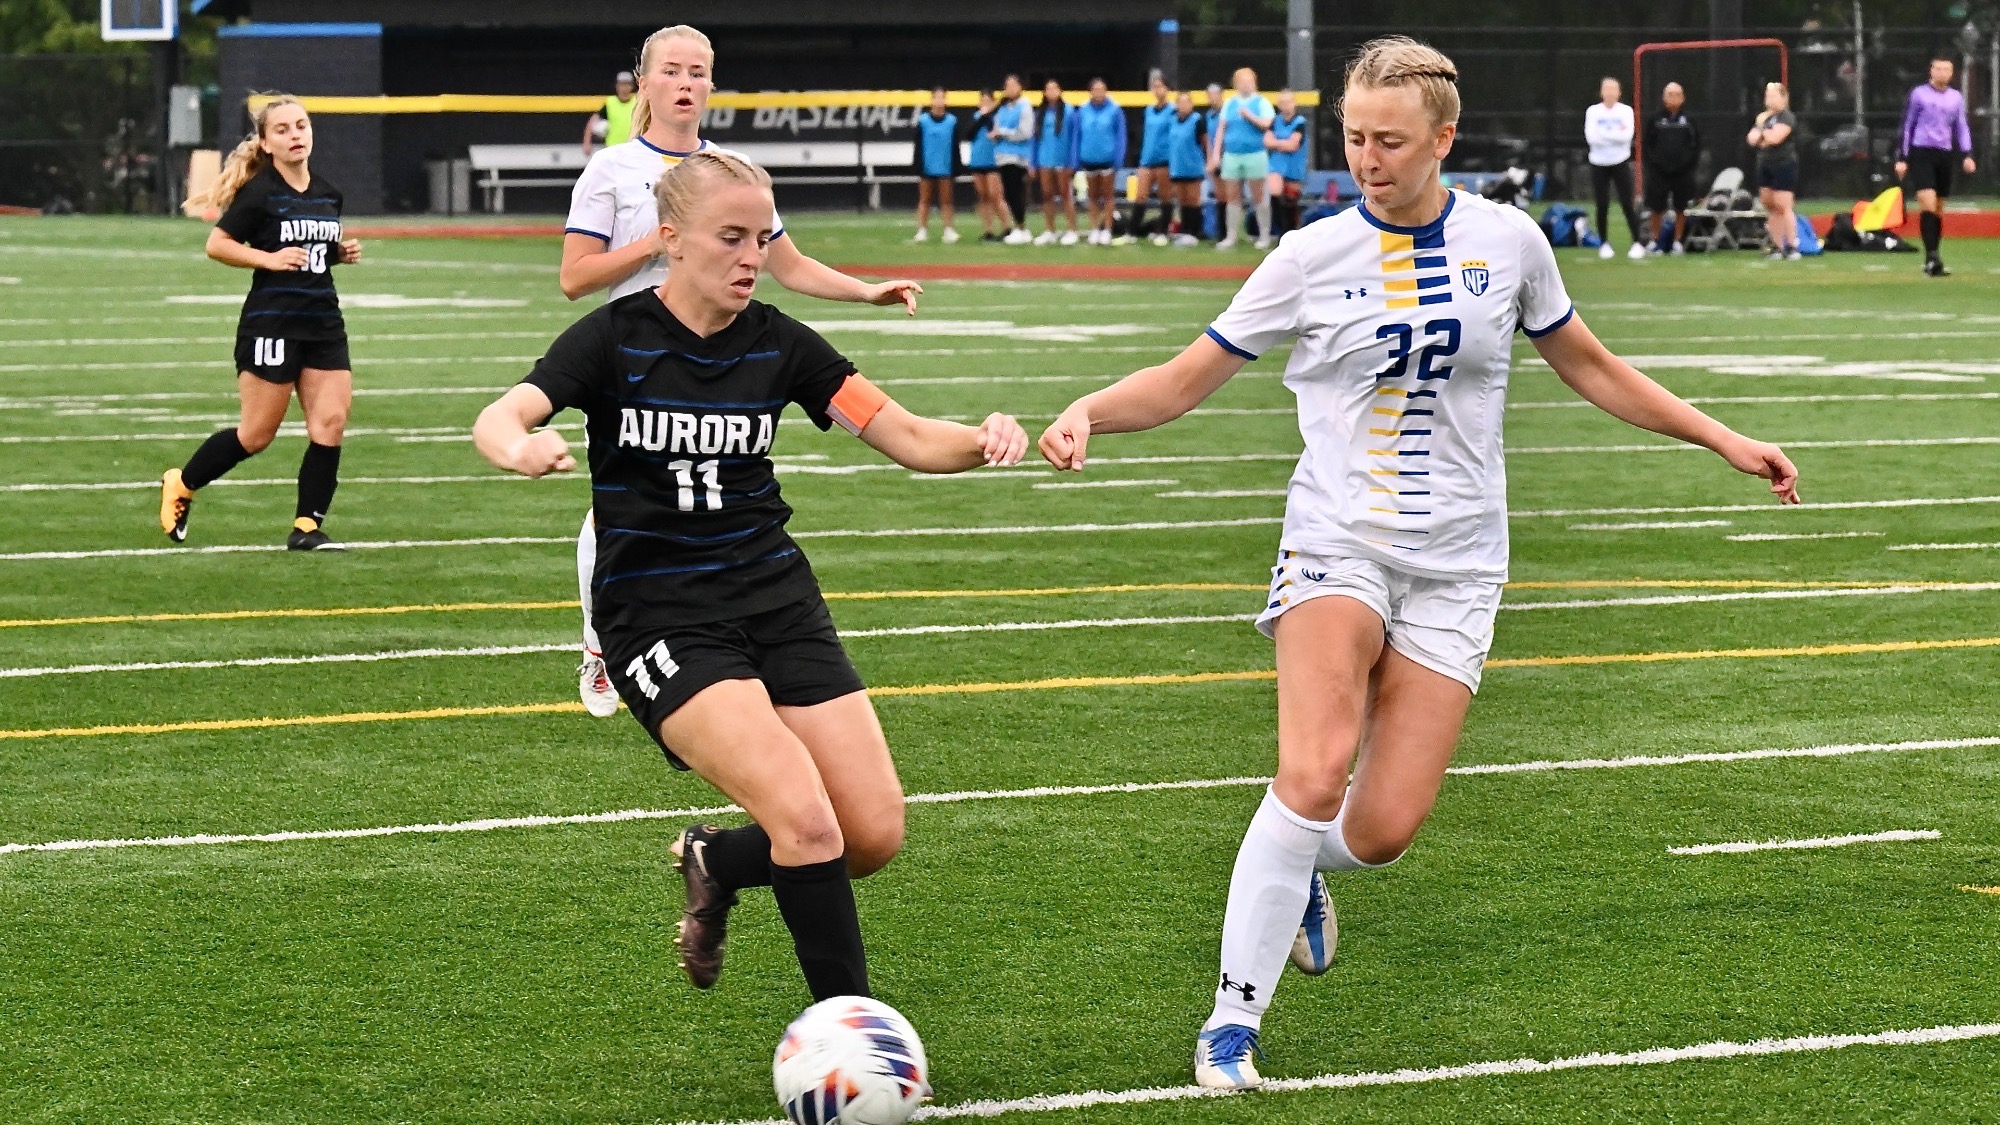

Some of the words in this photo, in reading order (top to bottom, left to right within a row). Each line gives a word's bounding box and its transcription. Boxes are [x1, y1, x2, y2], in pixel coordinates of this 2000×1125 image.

[280, 219, 343, 243] AUROR
[1462, 269, 1488, 295] NP
[254, 336, 285, 366] 10
[1376, 318, 1461, 382] 32
[618, 408, 773, 454] AURORA
[668, 459, 723, 512] 11
[625, 639, 680, 701] 11
